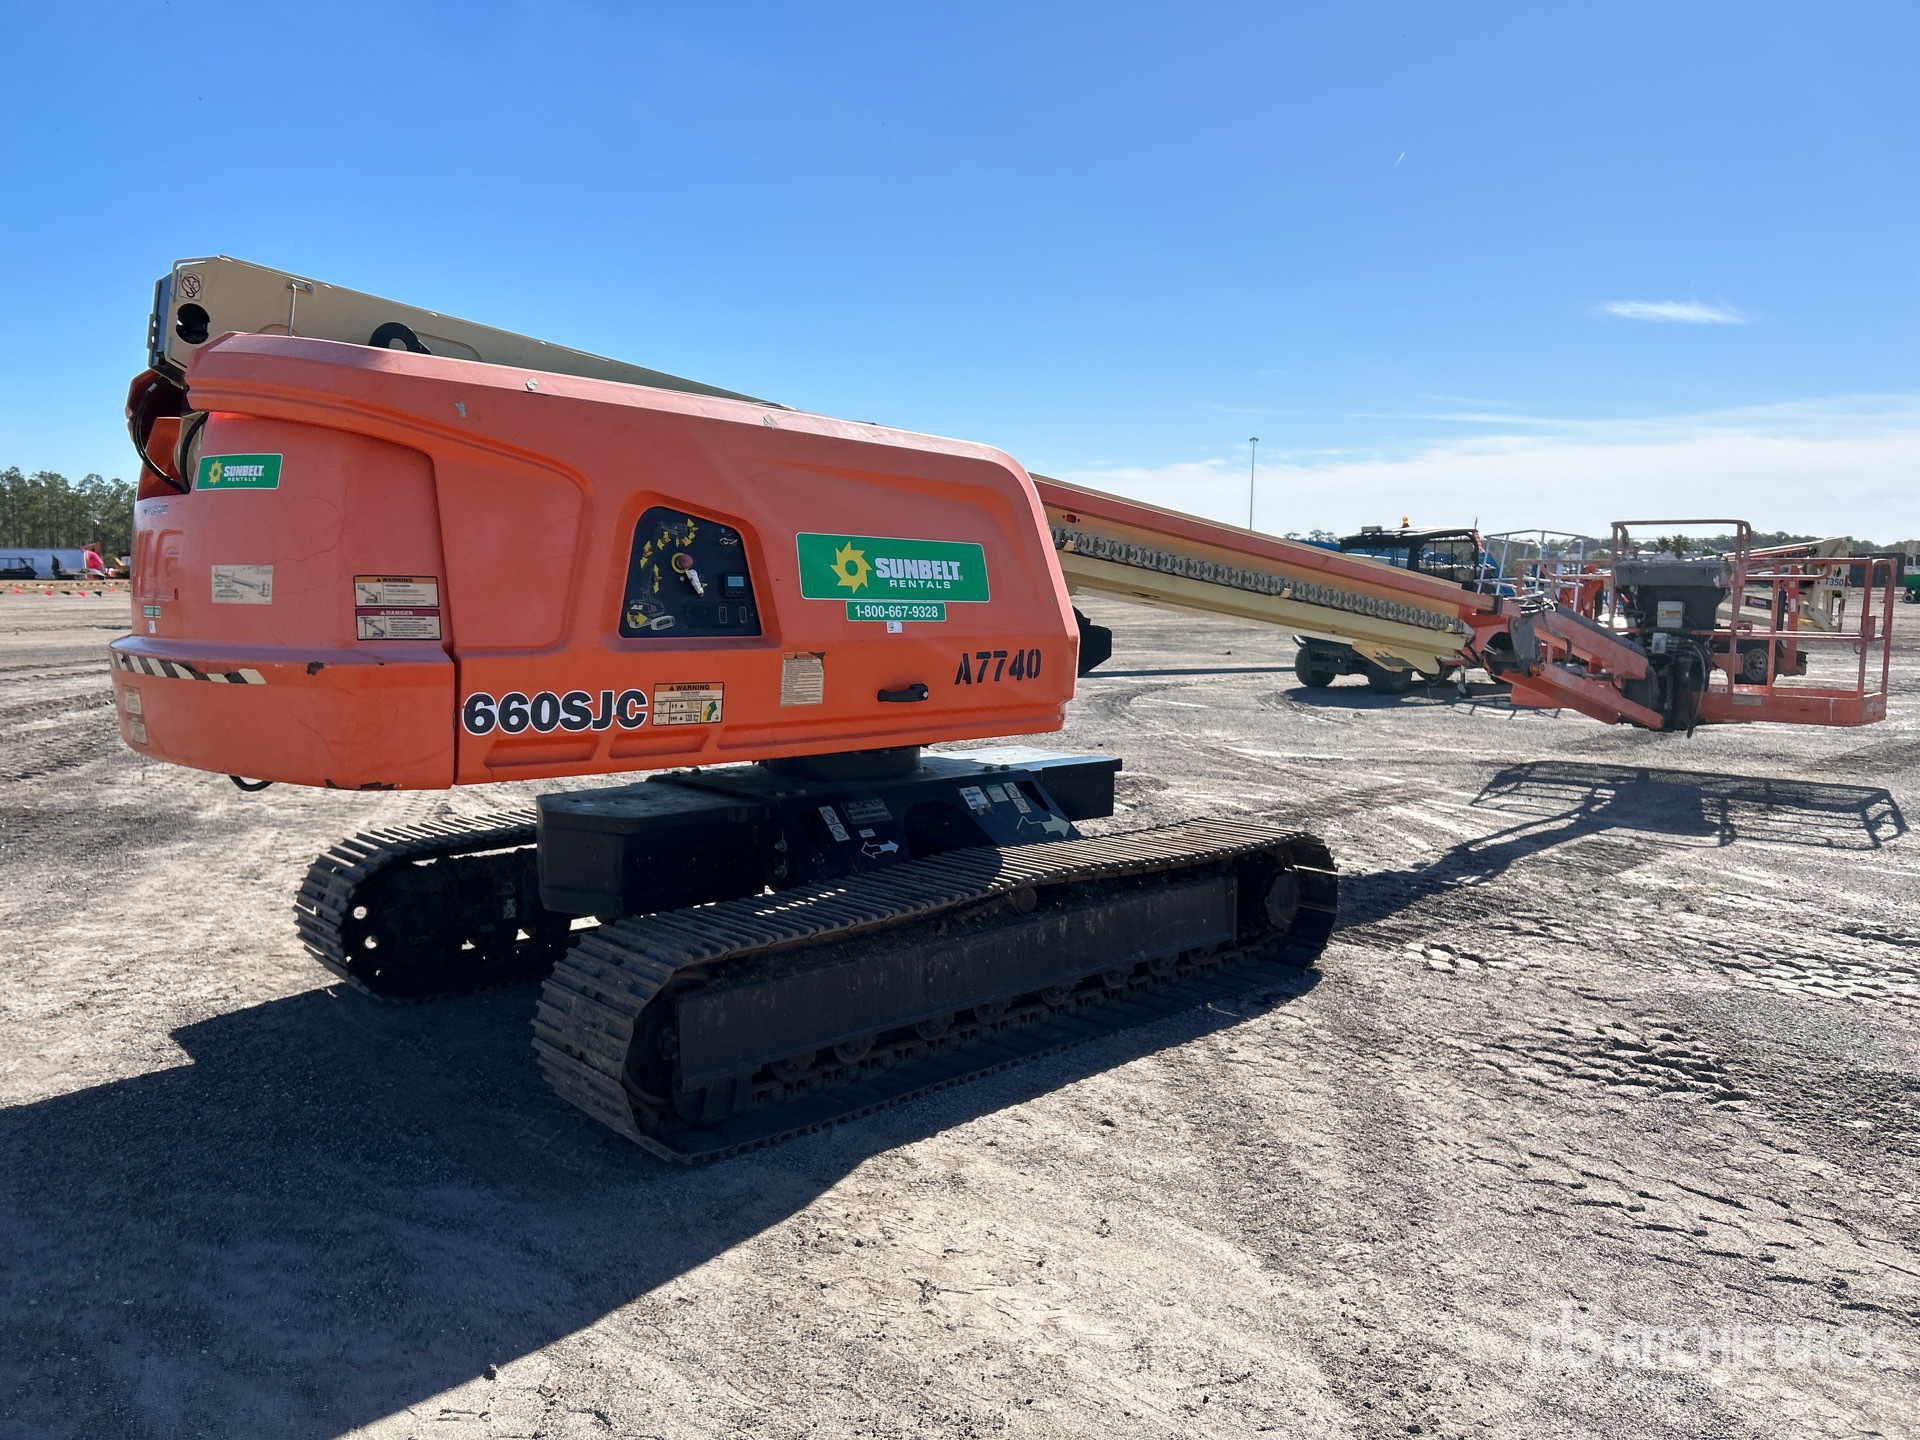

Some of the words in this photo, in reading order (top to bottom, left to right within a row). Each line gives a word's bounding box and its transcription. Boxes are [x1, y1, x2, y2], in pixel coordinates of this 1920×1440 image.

[224, 465, 264, 477] SUNBELT
[875, 557, 961, 581] SUNBELT
[890, 579, 951, 589] RENTALS
[854, 604, 938, 619] 1-800-667-9328
[955, 648, 1042, 686] A7740
[463, 688, 648, 736] 660SJC
